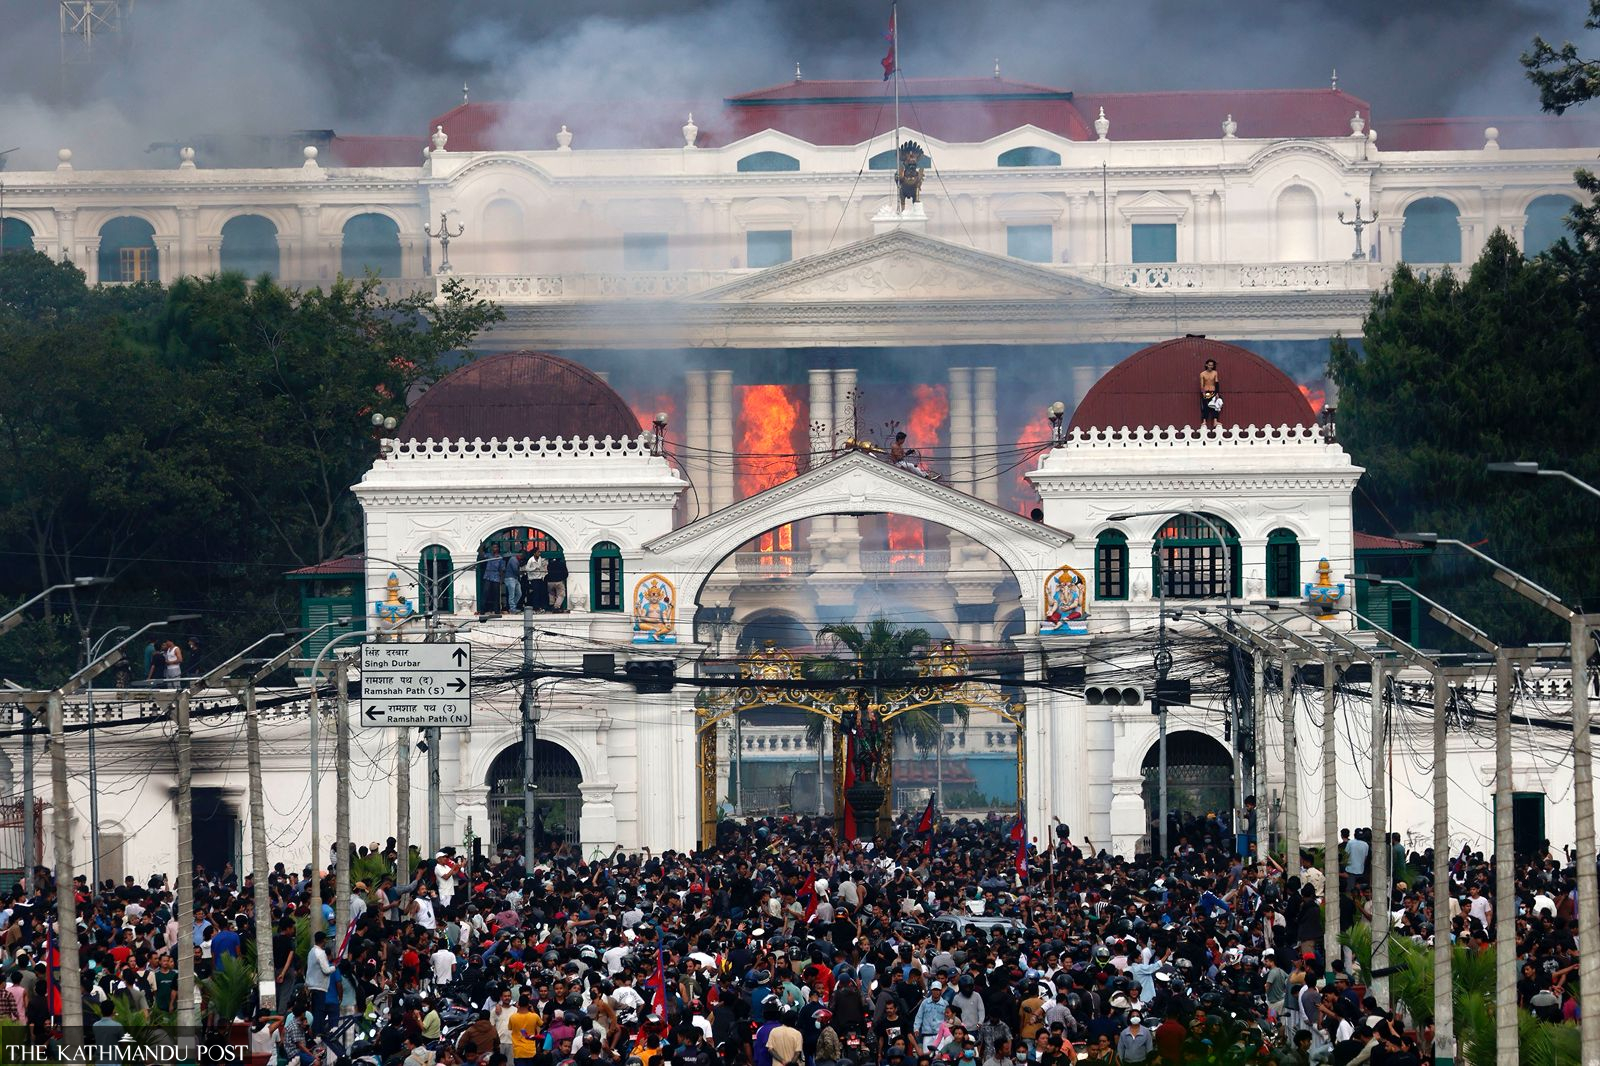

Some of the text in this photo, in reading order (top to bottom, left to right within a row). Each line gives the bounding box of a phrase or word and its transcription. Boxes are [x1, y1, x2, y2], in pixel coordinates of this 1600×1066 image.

[365, 647, 409, 657] सिंह दरबार
[364, 660, 389, 668] Singh
[364, 676, 434, 686] रामशाह पथ (द)
[364, 686, 445, 695] Ramshah Path (S)
[388, 704, 457, 714] रामशाह पथ (उ)
[387, 714, 468, 723] Ramshah Path (N)
